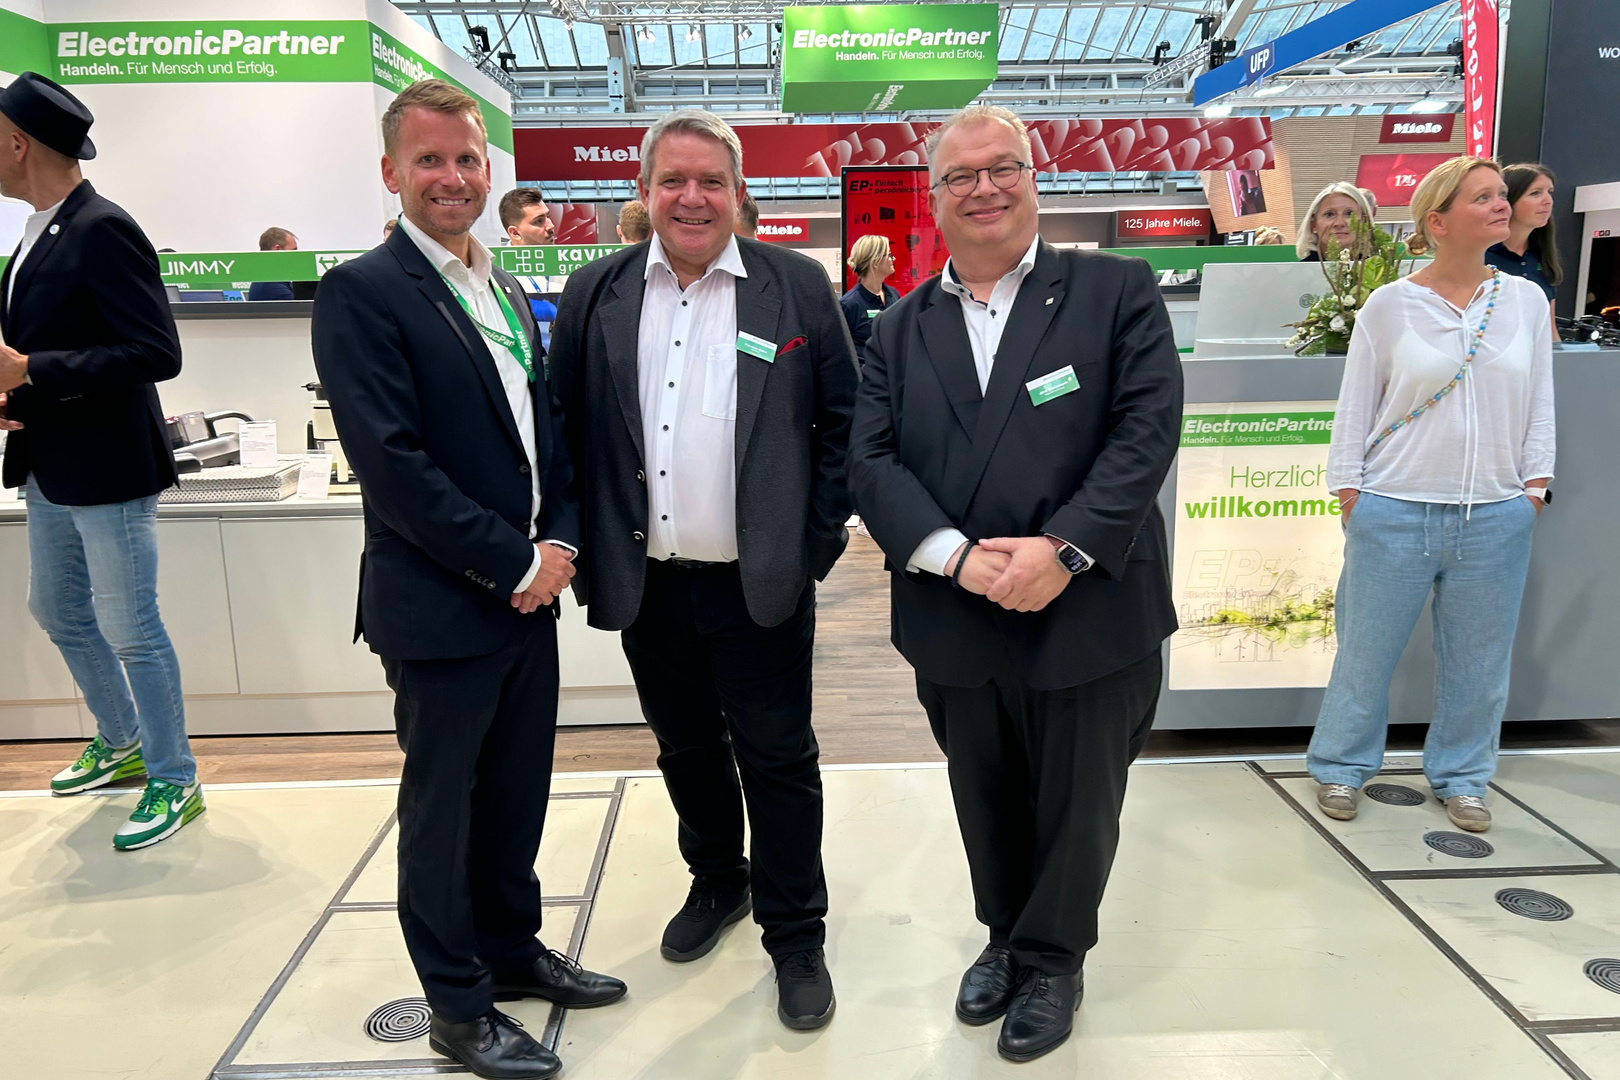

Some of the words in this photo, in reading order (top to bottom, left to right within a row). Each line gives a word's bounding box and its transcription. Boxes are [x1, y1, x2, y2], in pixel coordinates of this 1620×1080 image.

[57, 29, 345, 57] ElectronicPartner
[793, 27, 991, 48] ElectronicPartner
[372, 31, 435, 82] ElectronicPart
[836, 51, 880, 61] Handeln.
[882, 50, 897, 60] Für
[899, 49, 935, 59] Mensch
[937, 49, 955, 59] und
[956, 49, 986, 60] Erfolg.
[1250, 48, 1270, 74] UFP
[60, 63, 124, 76] Handeln.
[127, 61, 148, 75] Für
[152, 61, 204, 75] Mensch
[208, 61, 233, 74] und
[236, 60, 278, 77] Erfolg.
[1391, 122, 1443, 134] Miele
[573, 145, 641, 162] Miel
[848, 180, 873, 191] EP:
[874, 179, 903, 187] Einfach
[757, 225, 803, 236] Miele
[1124, 218, 1143, 229] 125
[1145, 218, 1170, 230] Jahre
[1173, 217, 1203, 228] Miele.
[161, 260, 235, 276] JIMMY
[1183, 417, 1334, 434] ElectronicPartne
[1183, 436, 1219, 445] Handeln.
[1220, 435, 1232, 443] Für
[1235, 434, 1264, 443] Mensch
[1265, 434, 1280, 442] und
[1281, 433, 1305, 443] Erfolg.
[1185, 496, 1342, 519] willkomme
